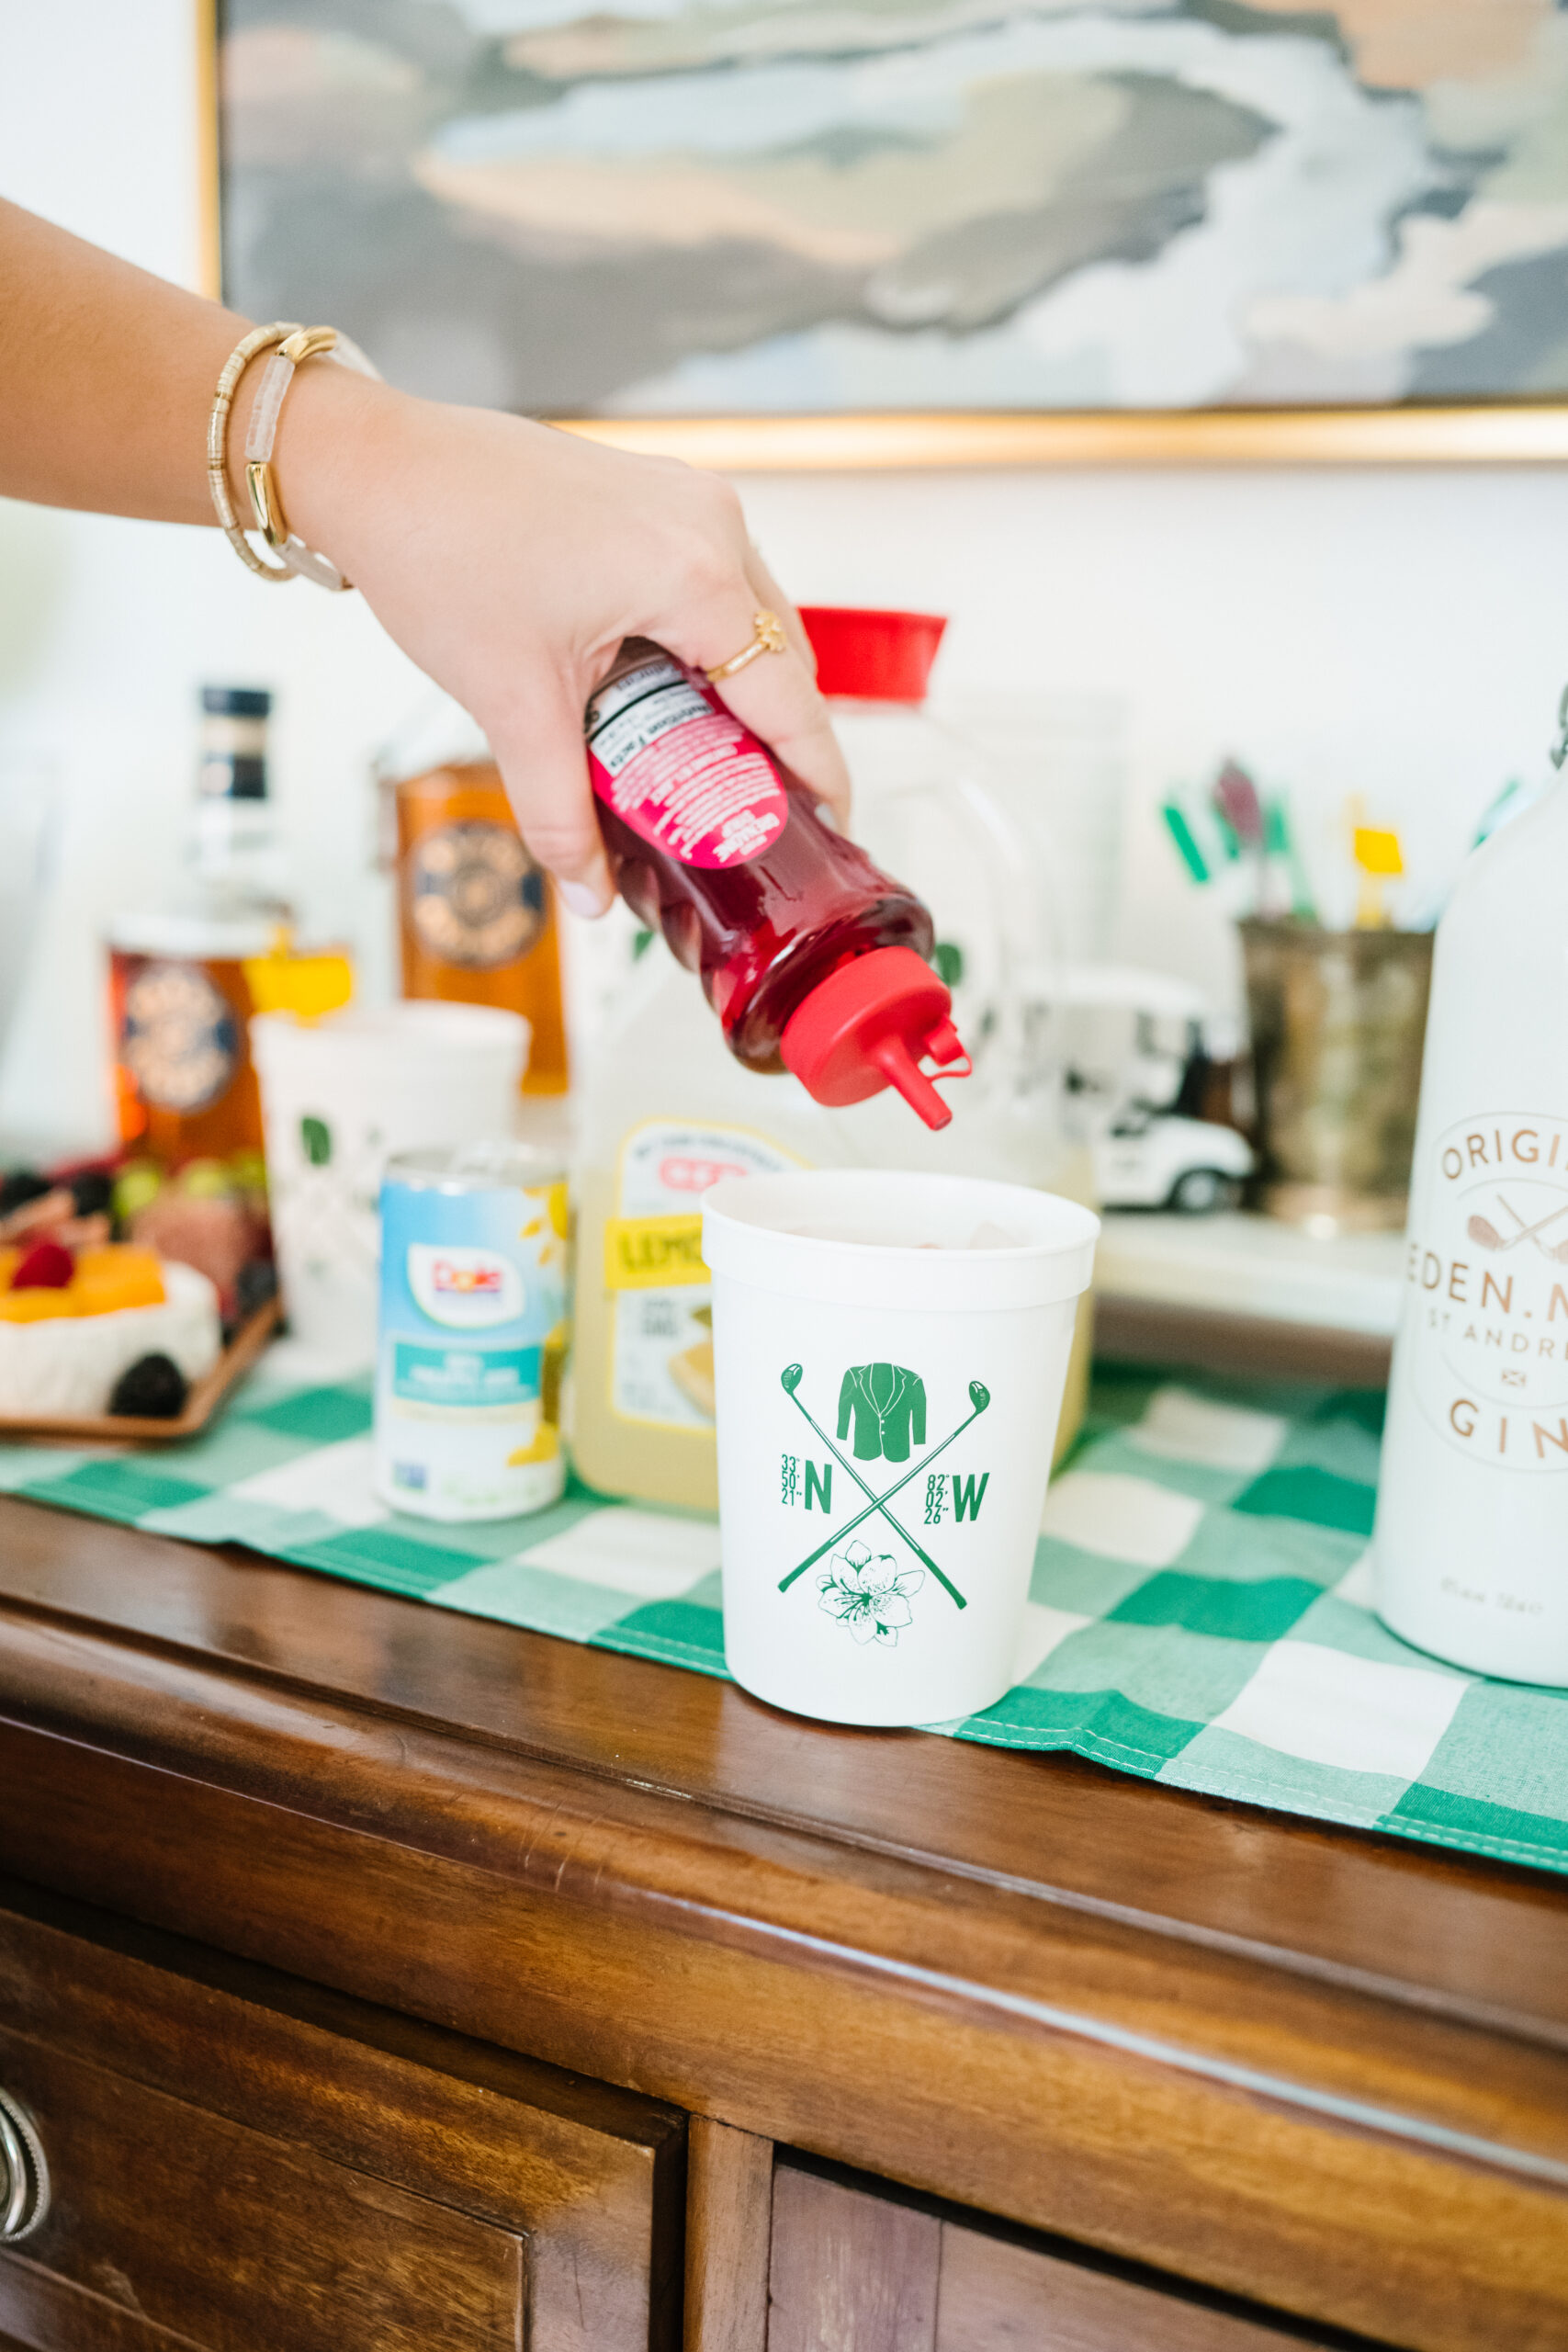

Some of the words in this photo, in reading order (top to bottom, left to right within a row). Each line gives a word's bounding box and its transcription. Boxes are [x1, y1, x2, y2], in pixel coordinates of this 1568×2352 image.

[1441, 1128, 1568, 1180] ORIGI
[1449, 1398, 1568, 1459] GIN
[804, 1459, 832, 1515] N
[952, 1472, 990, 1523] W
